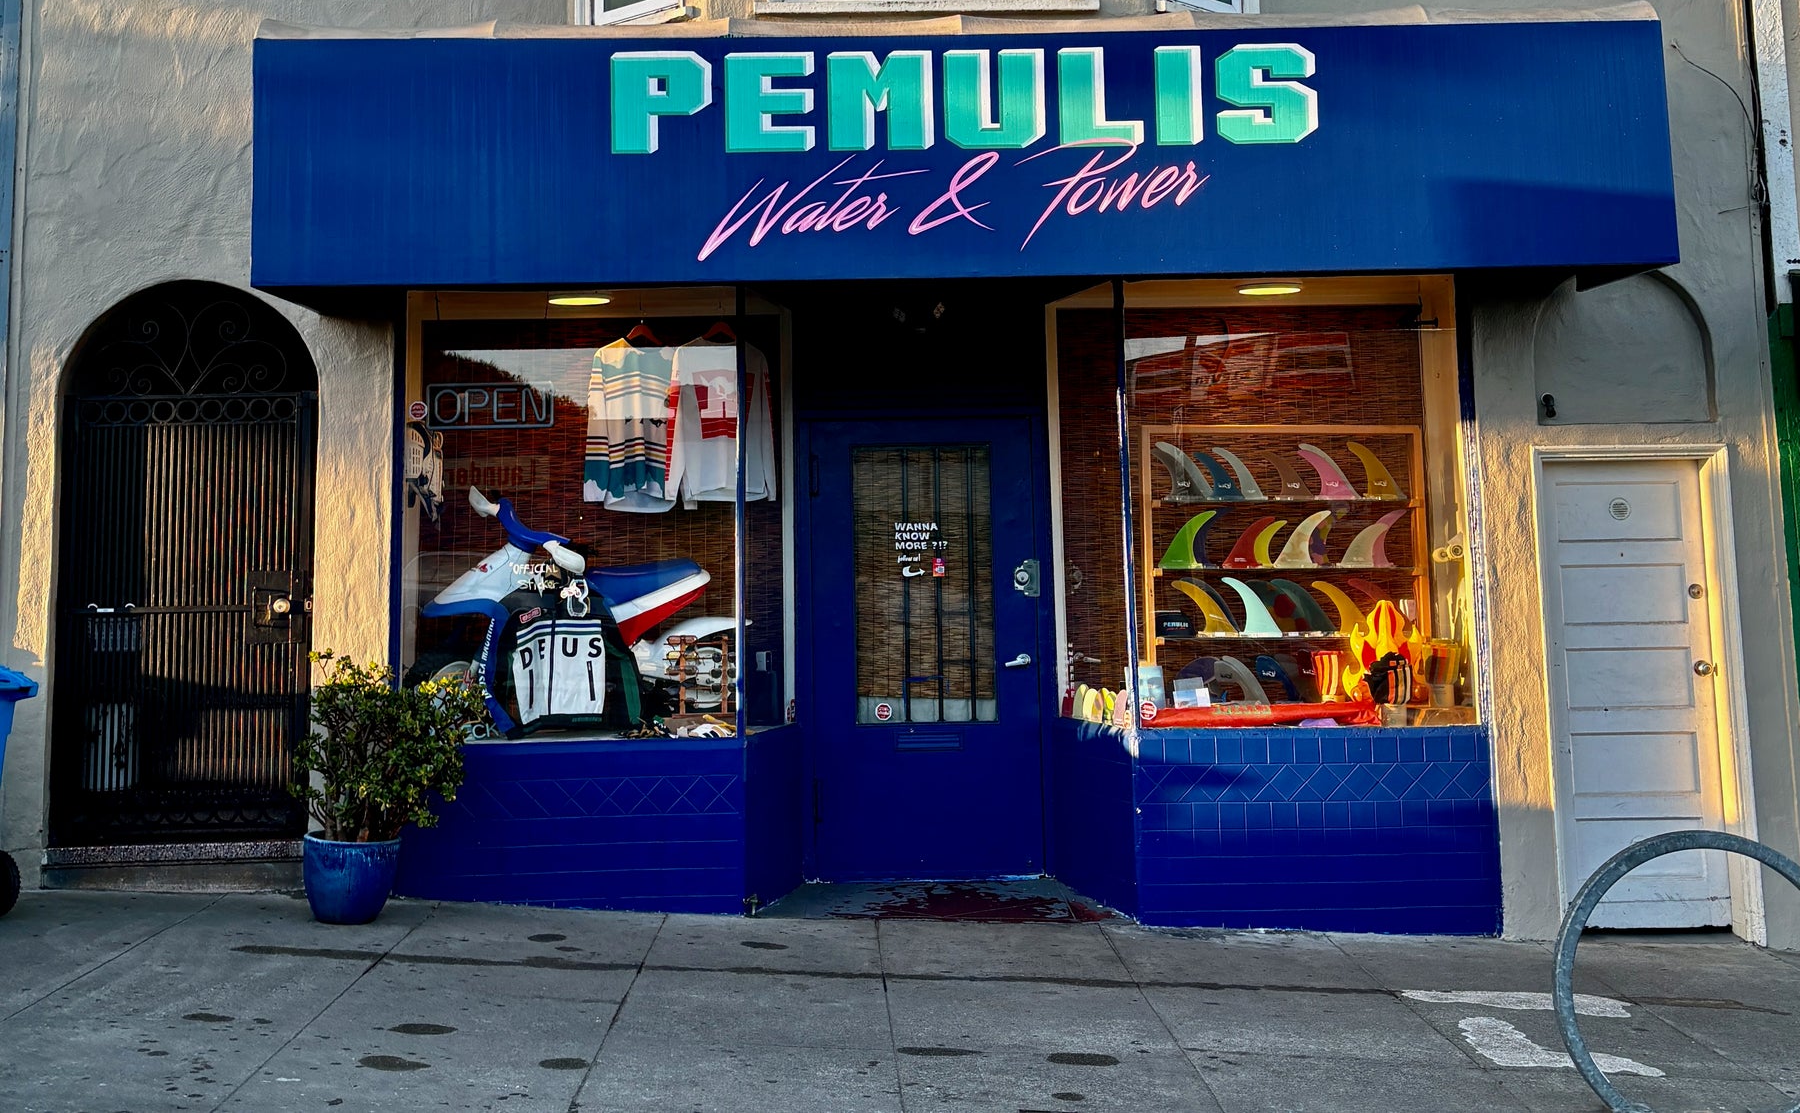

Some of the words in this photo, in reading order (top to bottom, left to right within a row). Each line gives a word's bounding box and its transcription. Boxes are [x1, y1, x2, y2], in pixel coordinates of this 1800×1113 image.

[611, 43, 1319, 154] PEMULIS
[697, 154, 930, 261] Water
[908, 151, 995, 236] &
[1014, 137, 1210, 251] Power
[434, 388, 547, 423] OPEN
[895, 522, 938, 531] WANNA
[895, 532, 930, 541] KNOW
[896, 541, 927, 550] MORE
[519, 636, 602, 670] DEUS
